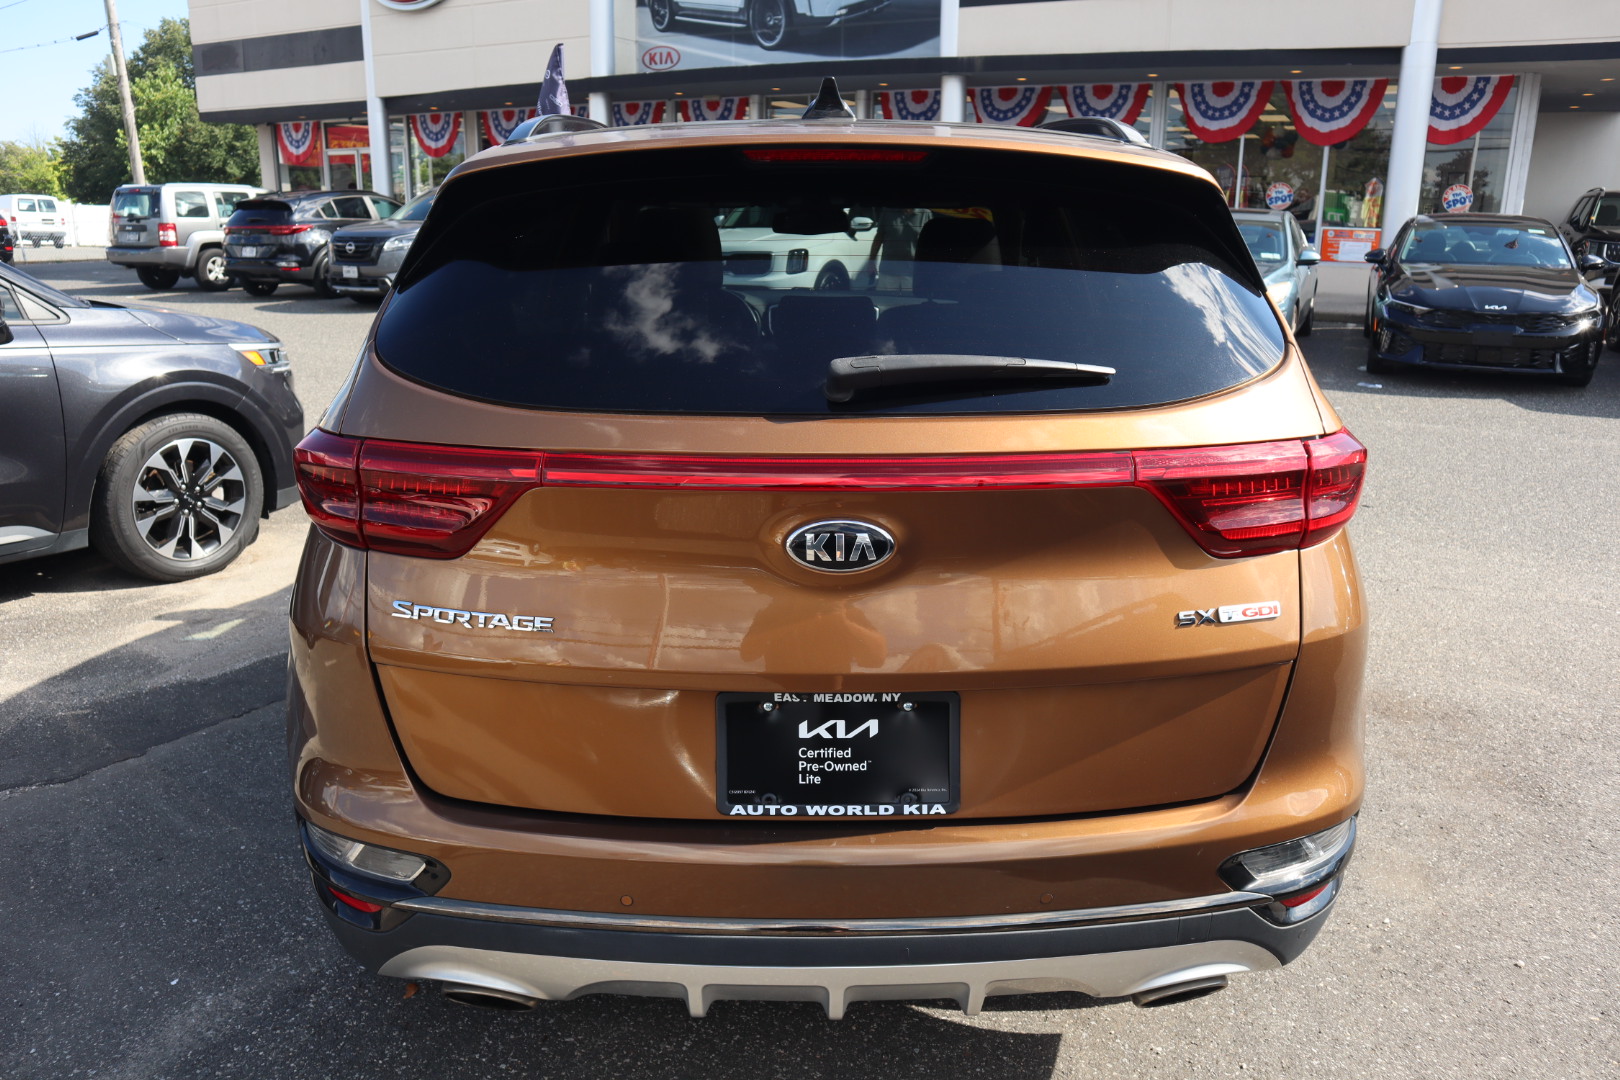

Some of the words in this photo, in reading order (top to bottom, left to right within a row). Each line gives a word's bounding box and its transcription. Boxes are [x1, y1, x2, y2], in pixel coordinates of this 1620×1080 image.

[649, 51, 674, 65] KIA
[1268, 194, 1293, 206] SPOT
[1445, 194, 1473, 209] SPOT
[804, 533, 877, 562] KIA
[391, 600, 555, 633] SPORTAGE
[1178, 608, 1217, 626] SX
[881, 692, 902, 702] NY
[798, 718, 879, 739] KIA
[798, 747, 852, 758] Certified
[798, 773, 821, 784] Lite
[729, 804, 798, 816] AUTO
[805, 804, 895, 816] WORLD
[903, 803, 947, 815] KIA
